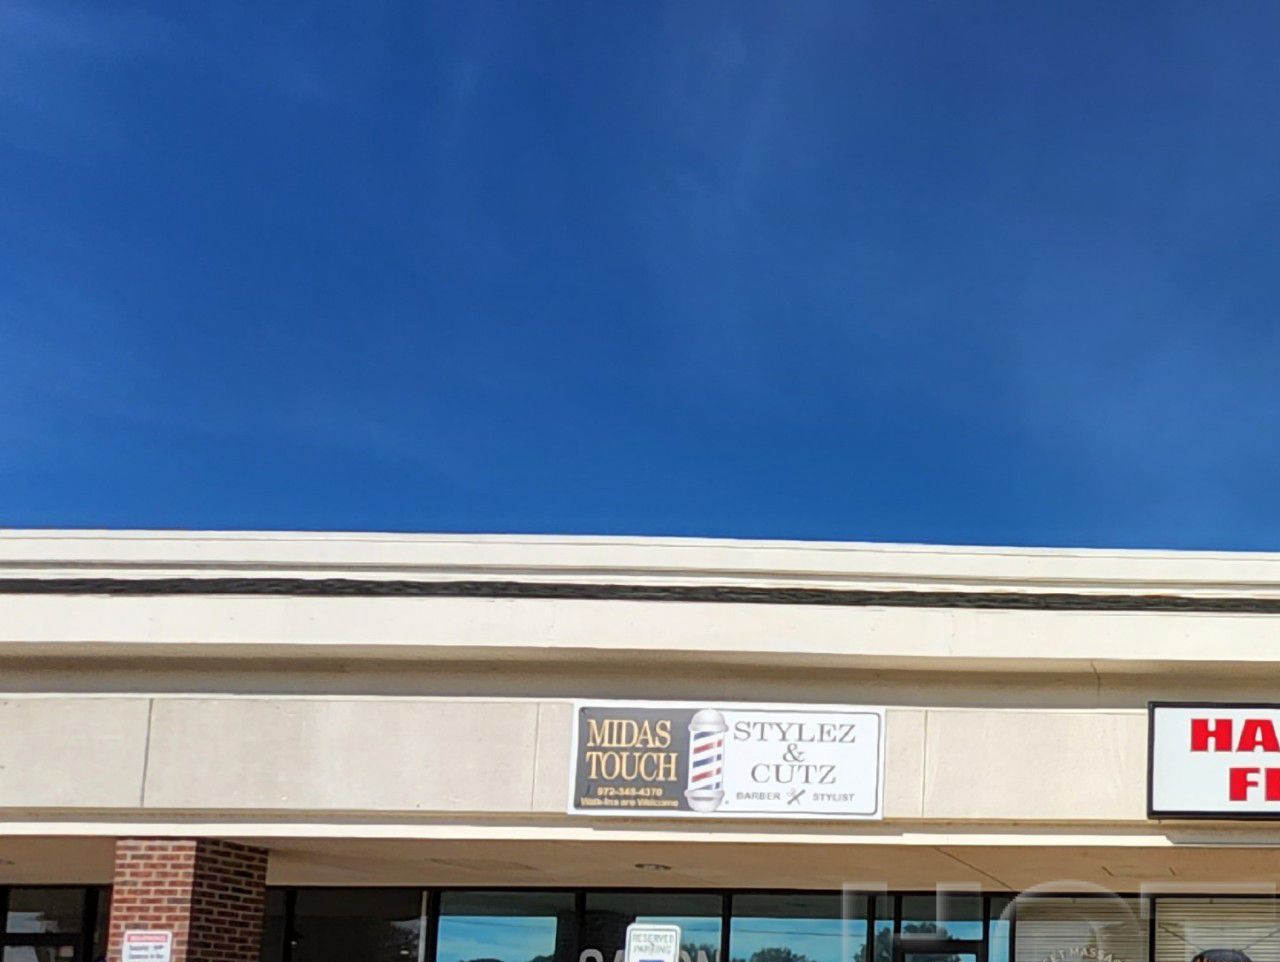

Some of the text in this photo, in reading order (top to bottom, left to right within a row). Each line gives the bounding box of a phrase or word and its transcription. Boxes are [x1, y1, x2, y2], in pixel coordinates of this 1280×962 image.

[587, 719, 671, 749] MIDAS
[733, 720, 856, 744] STYLEZ
[782, 743, 805, 763] &
[586, 751, 678, 781] TOUCH
[751, 764, 837, 785] CUTZ
[736, 792, 781, 801] BARBER
[812, 793, 855, 802] STYLIST
